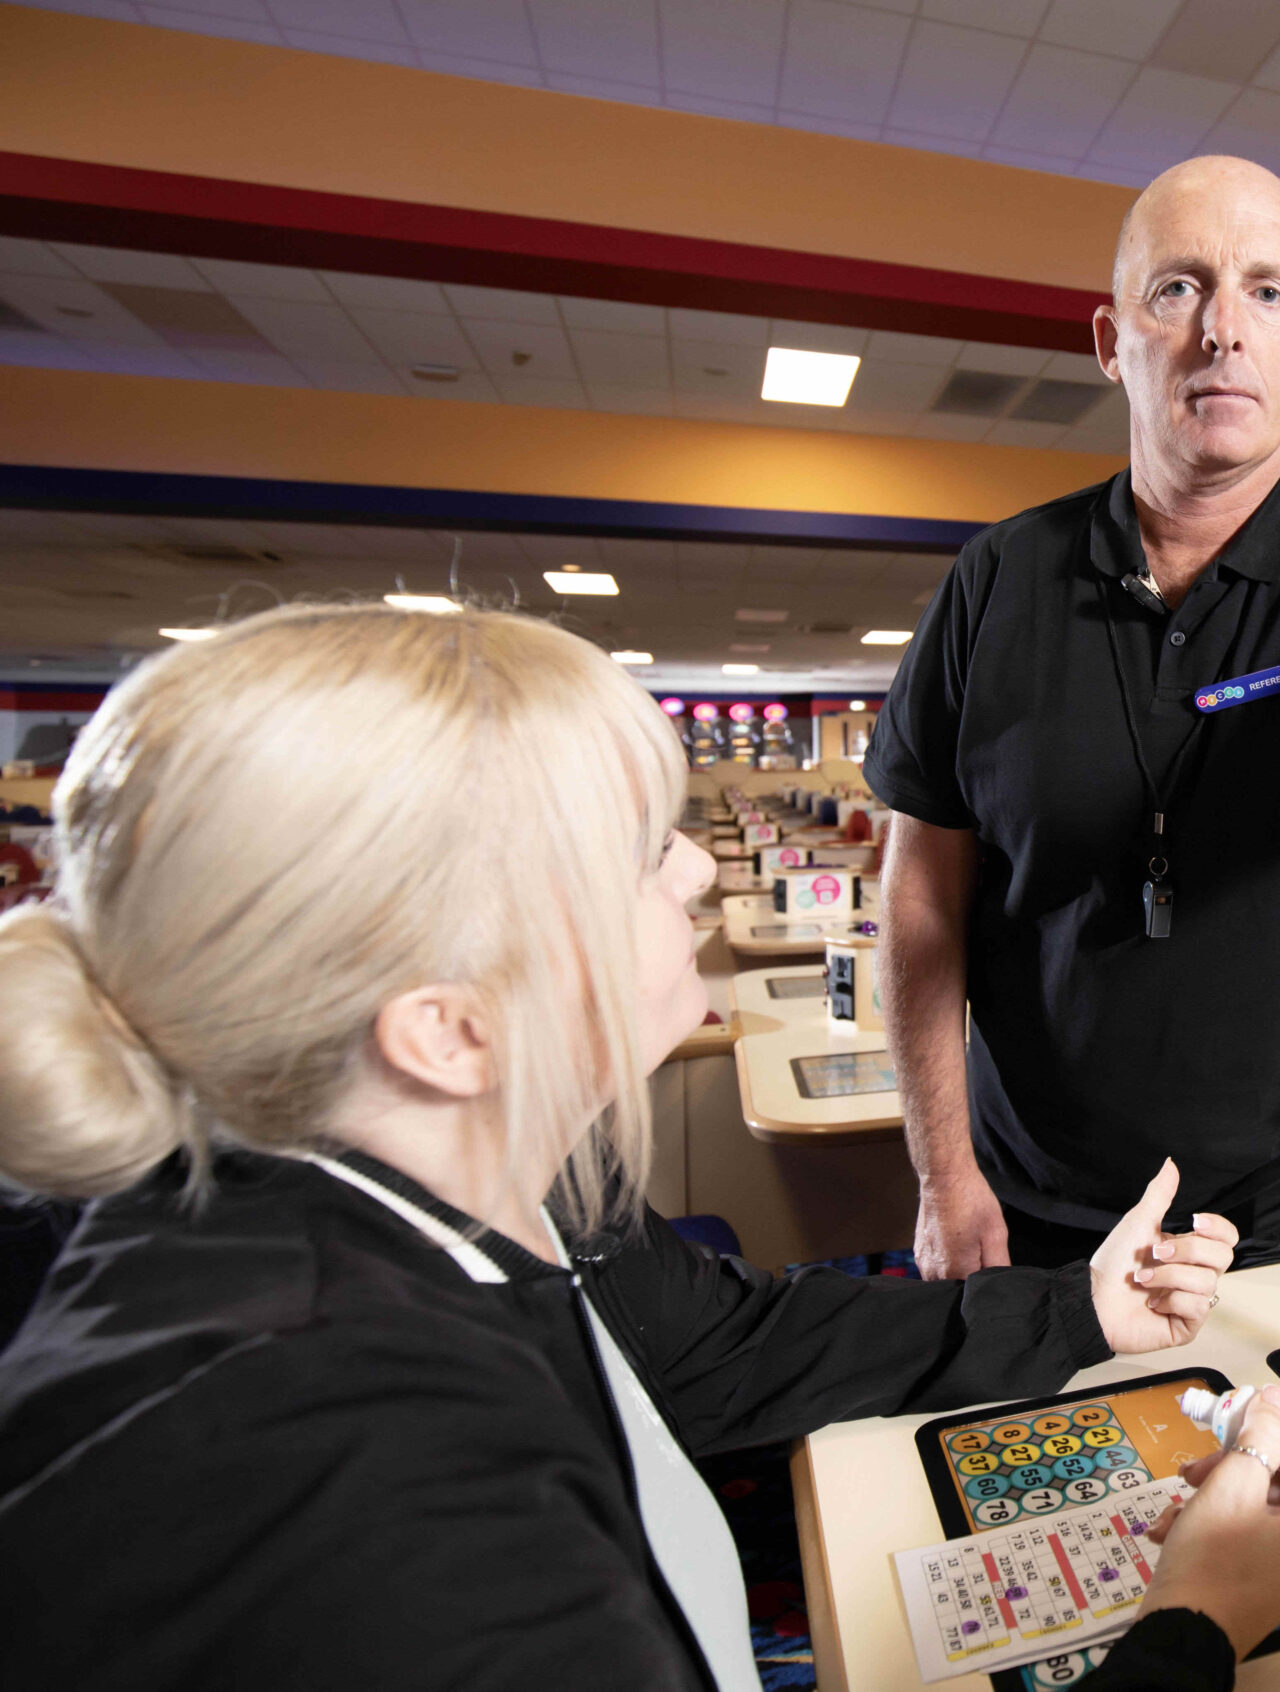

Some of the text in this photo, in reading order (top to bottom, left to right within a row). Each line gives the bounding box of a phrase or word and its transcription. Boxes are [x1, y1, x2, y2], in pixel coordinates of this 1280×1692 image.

[1082, 1412, 1140, 1489] 2 21 44 63
[1044, 1421, 1099, 1500] 4 26 52 64
[1002, 1429, 1055, 1510] 8 27 55 71
[961, 1434, 1009, 1521] 17 37 60 78
[1144, 1509, 1157, 1519] 23
[1060, 1528, 1072, 1537] 16
[1100, 1527, 1112, 1537] 25
[1014, 1541, 1026, 1551] 19
[1032, 1536, 1044, 1546] 12
[1069, 1546, 1081, 1556] 37
[1110, 1546, 1123, 1556] 48
[947, 1558, 959, 1568] 13
[999, 1556, 1009, 1566] 22
[1022, 1560, 1034, 1571] 35
[1078, 1523, 1125, 1603] 14 26 57 83
[1115, 1555, 1127, 1566] 51
[1002, 1566, 1014, 1576] 39
[1026, 1571, 1038, 1582] 42
[954, 1578, 965, 1588] 34
[972, 1573, 984, 1584] 31
[1049, 1576, 1061, 1586] 50
[1083, 1578, 1094, 1589] 64
[958, 1589, 969, 1598] 40
[1053, 1587, 1066, 1597] 67
[1087, 1588, 1100, 1600] 70
[1130, 1585, 1144, 1597] 81
[928, 1562, 962, 1651] 15 21 43 77 87
[984, 1606, 995, 1616] 61
[1018, 1608, 1031, 1620] 72
[1062, 1610, 1076, 1621] 85
[988, 1616, 999, 1628] 71
[1043, 1615, 1056, 1627] 90
